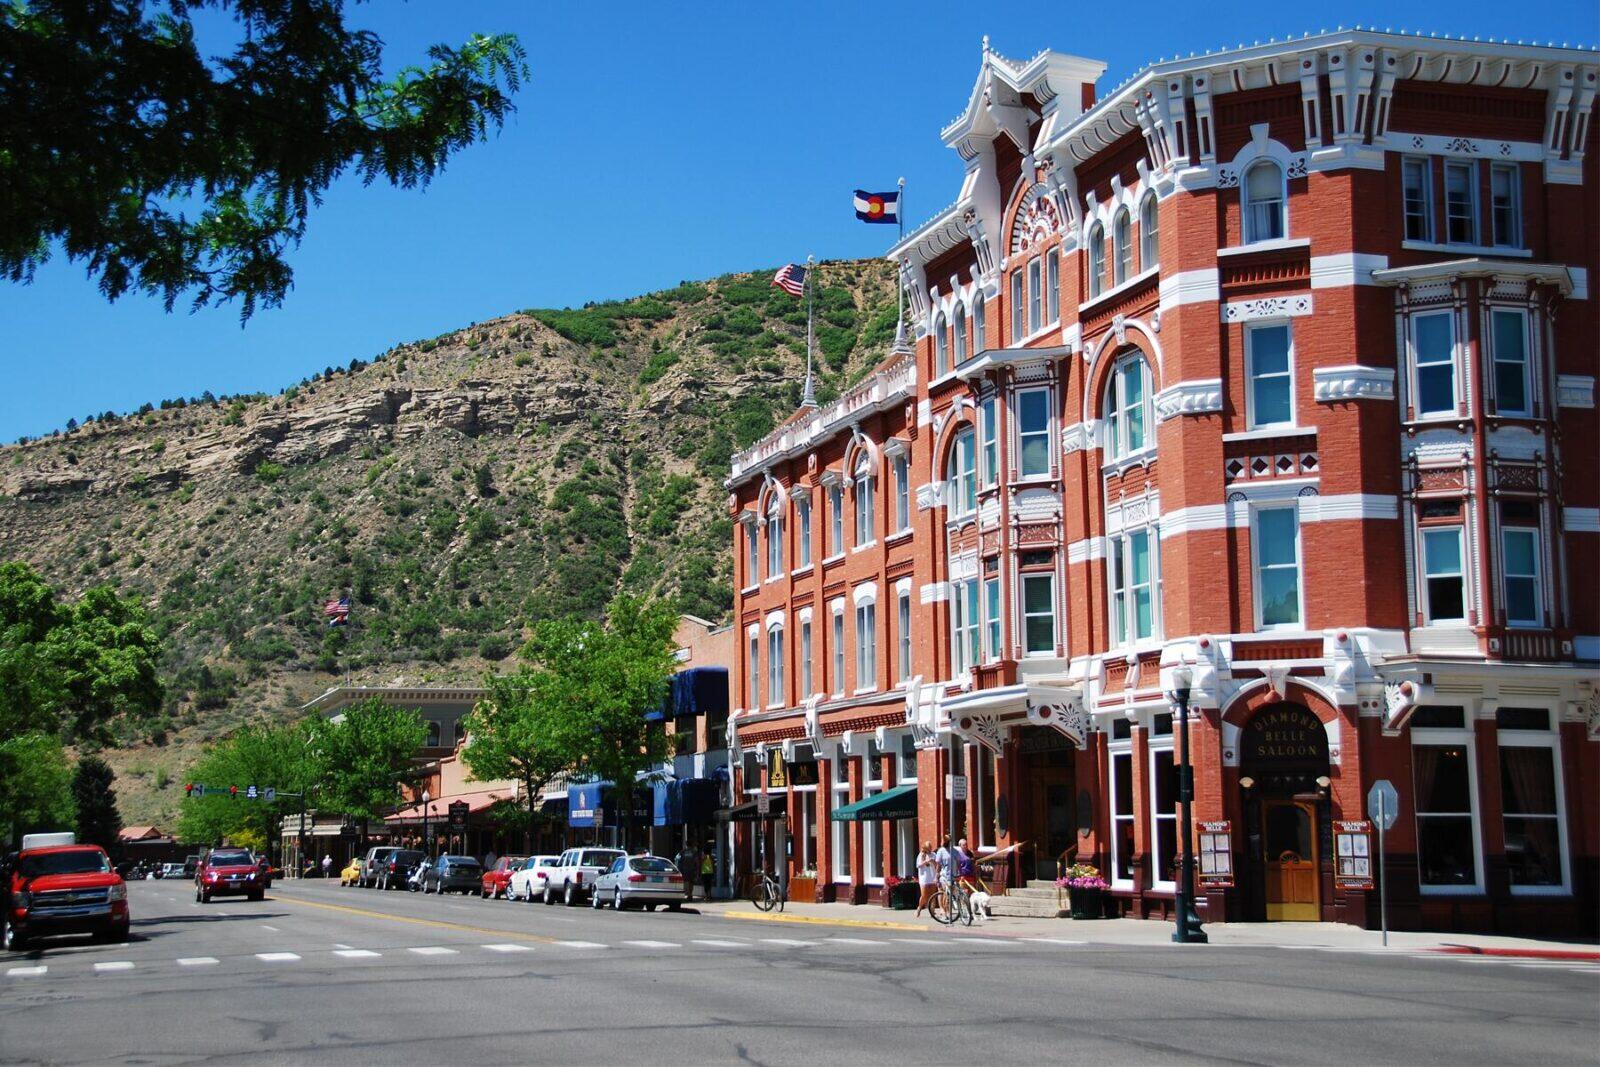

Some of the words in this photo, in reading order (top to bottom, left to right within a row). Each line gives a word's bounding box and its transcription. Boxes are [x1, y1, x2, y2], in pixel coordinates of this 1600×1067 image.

[1255, 712, 1318, 730] DIAMOND
[1265, 730, 1305, 741] BELLE
[1257, 745, 1317, 756] SALOON
